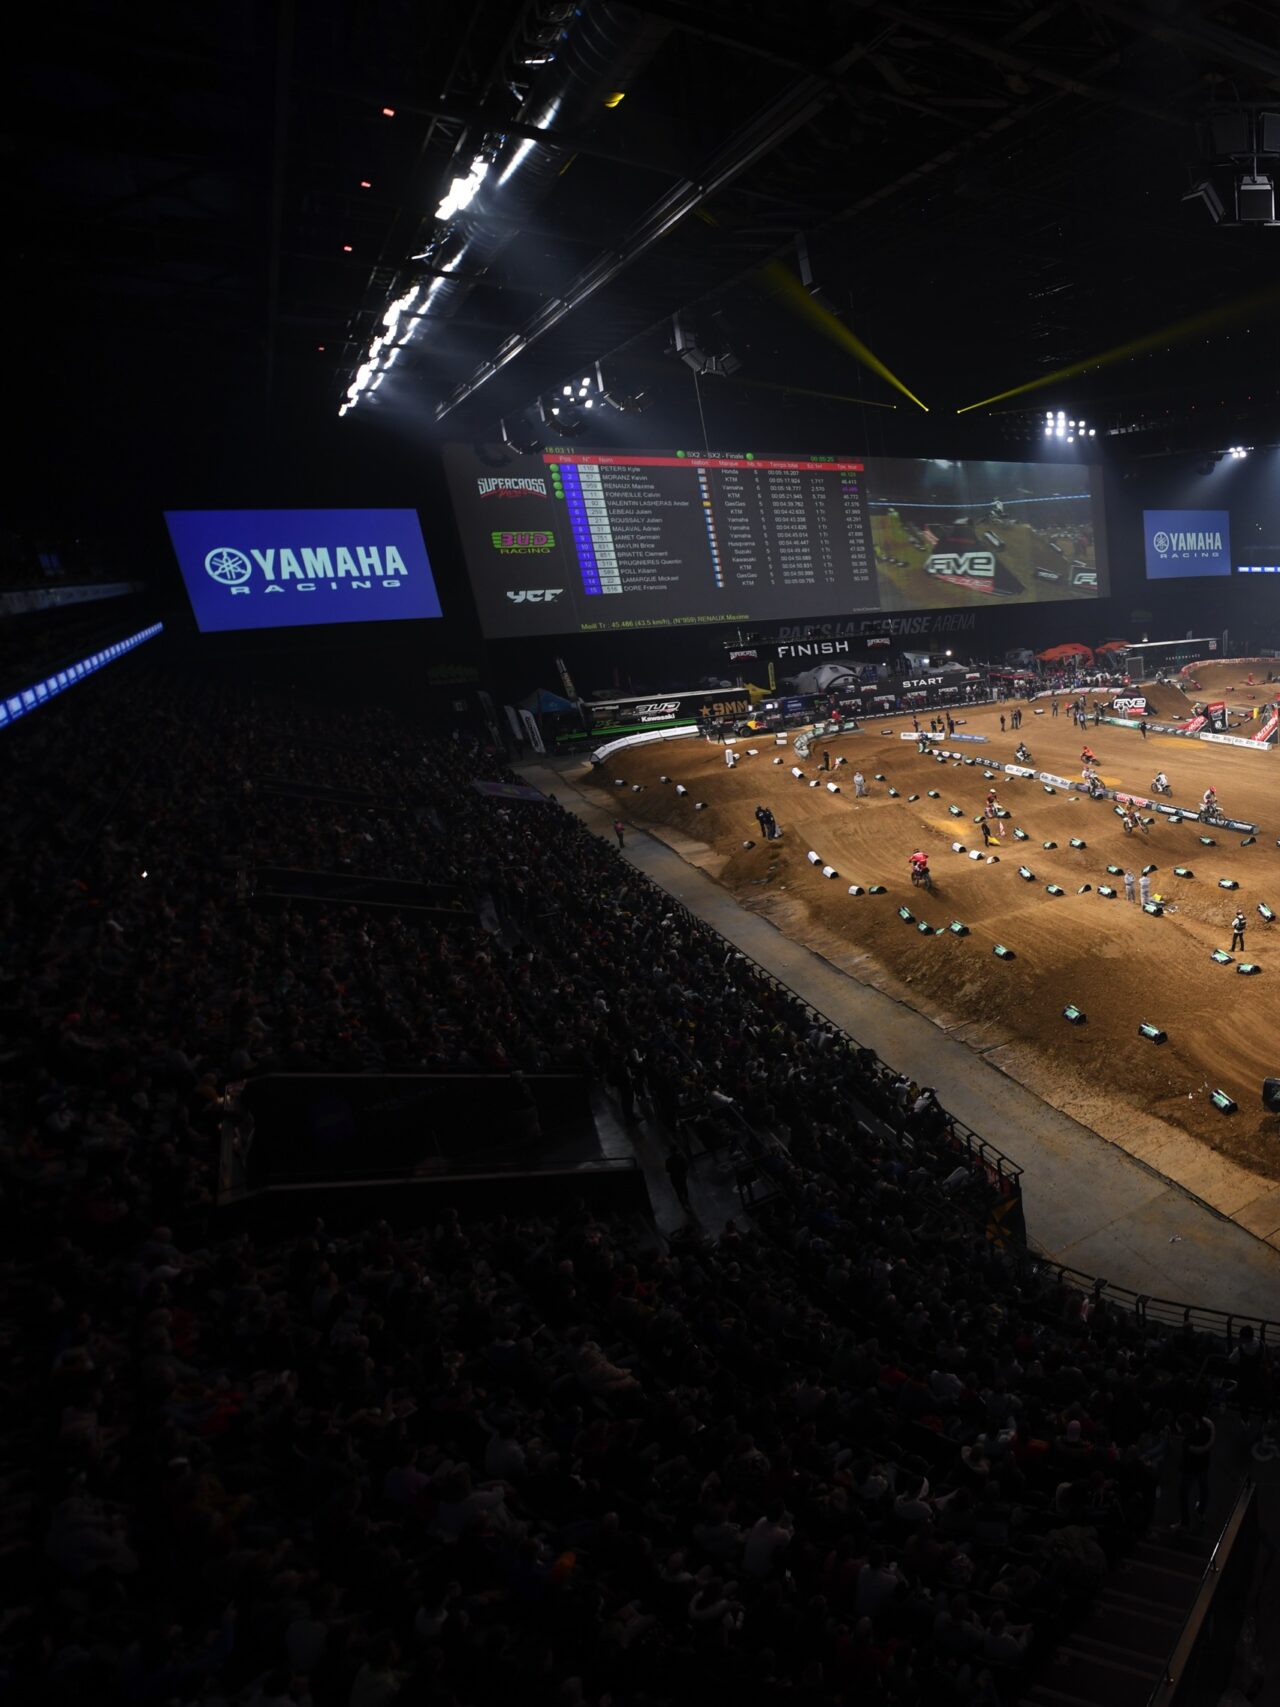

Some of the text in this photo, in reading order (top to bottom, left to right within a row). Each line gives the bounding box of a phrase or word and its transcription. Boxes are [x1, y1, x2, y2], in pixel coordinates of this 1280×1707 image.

[477, 477, 547, 495] SUPERCROSS
[1170, 532, 1222, 550] YAMAHA
[250, 545, 408, 580] YAMAHA
[230, 579, 401, 595] RACING
[932, 613, 976, 632] ARENA
[778, 640, 849, 659] FINISH
[902, 676, 944, 688] START
[712, 700, 748, 715] 9MM
